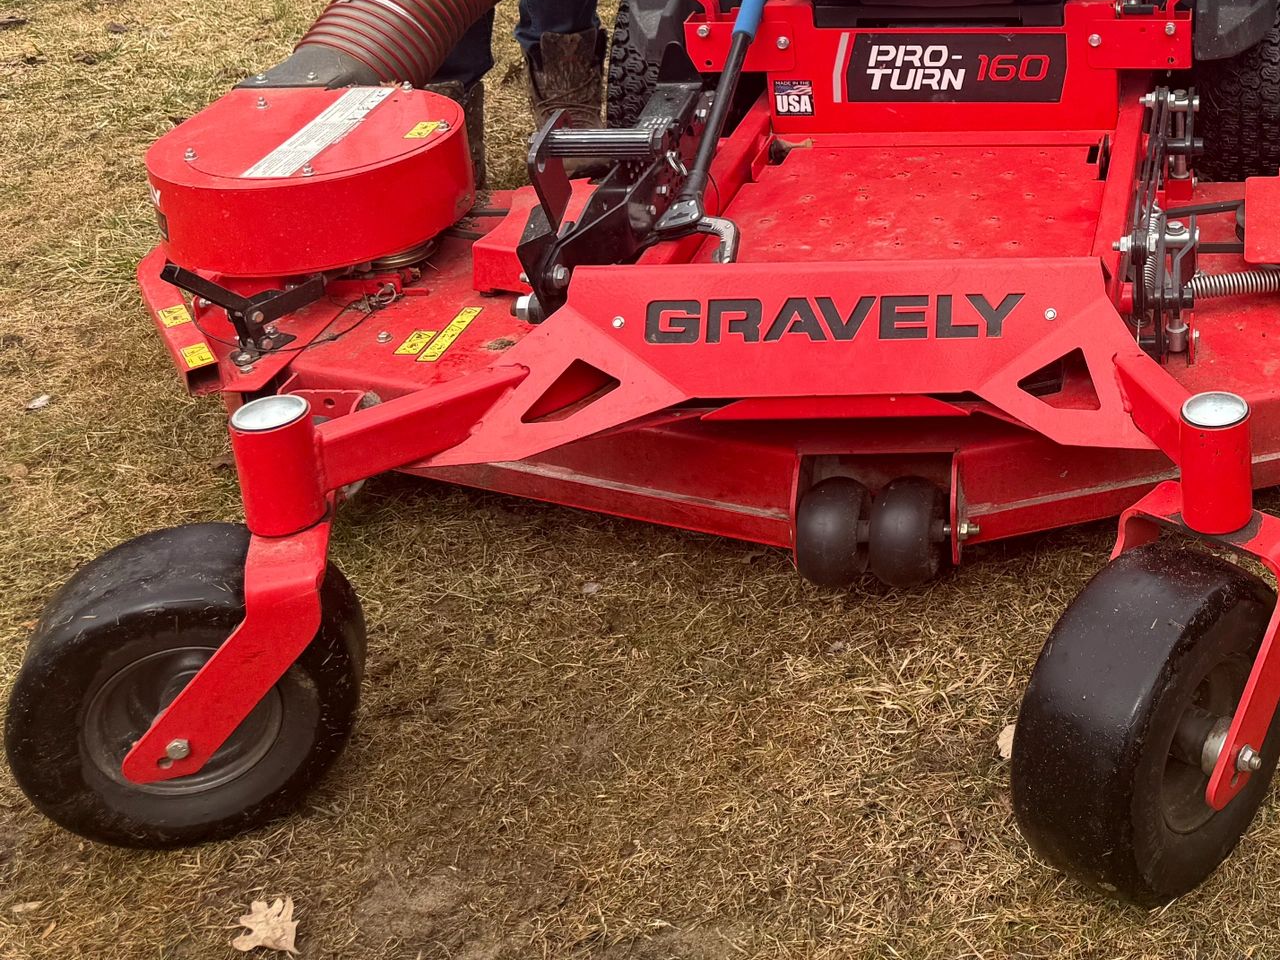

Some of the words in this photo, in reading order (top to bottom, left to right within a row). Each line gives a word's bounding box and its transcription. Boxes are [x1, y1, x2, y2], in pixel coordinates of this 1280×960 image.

[868, 45, 963, 67] PRO-
[976, 54, 1050, 81] 160
[866, 68, 965, 90] TURN
[776, 94, 813, 113] USA
[644, 292, 1027, 345] GRAVELY
